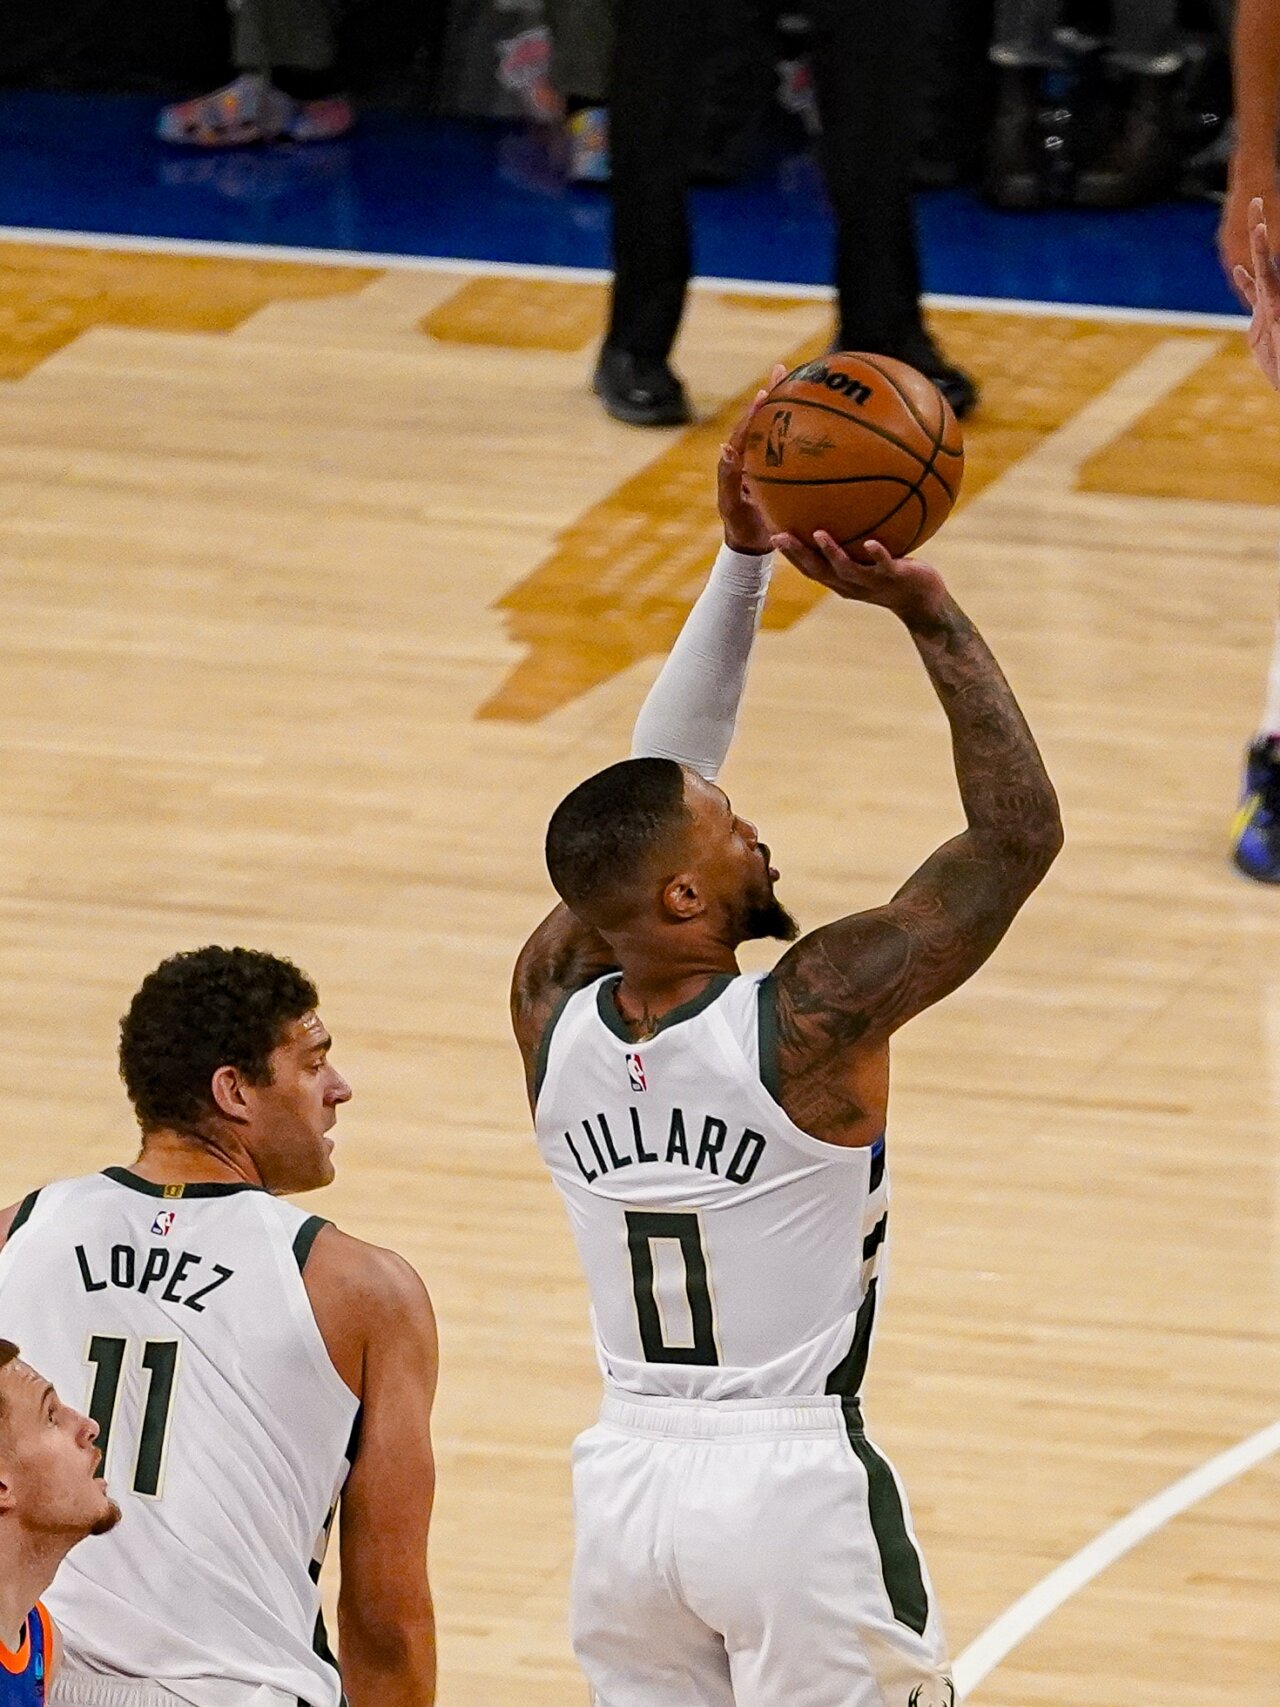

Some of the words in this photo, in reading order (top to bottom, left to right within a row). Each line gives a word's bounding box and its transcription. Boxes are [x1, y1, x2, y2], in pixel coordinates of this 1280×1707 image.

[564, 1106, 767, 1185] LILLARD
[74, 1243, 235, 1313] LOPEZ
[622, 1208, 721, 1367] 0
[85, 1333, 180, 1501] 11
